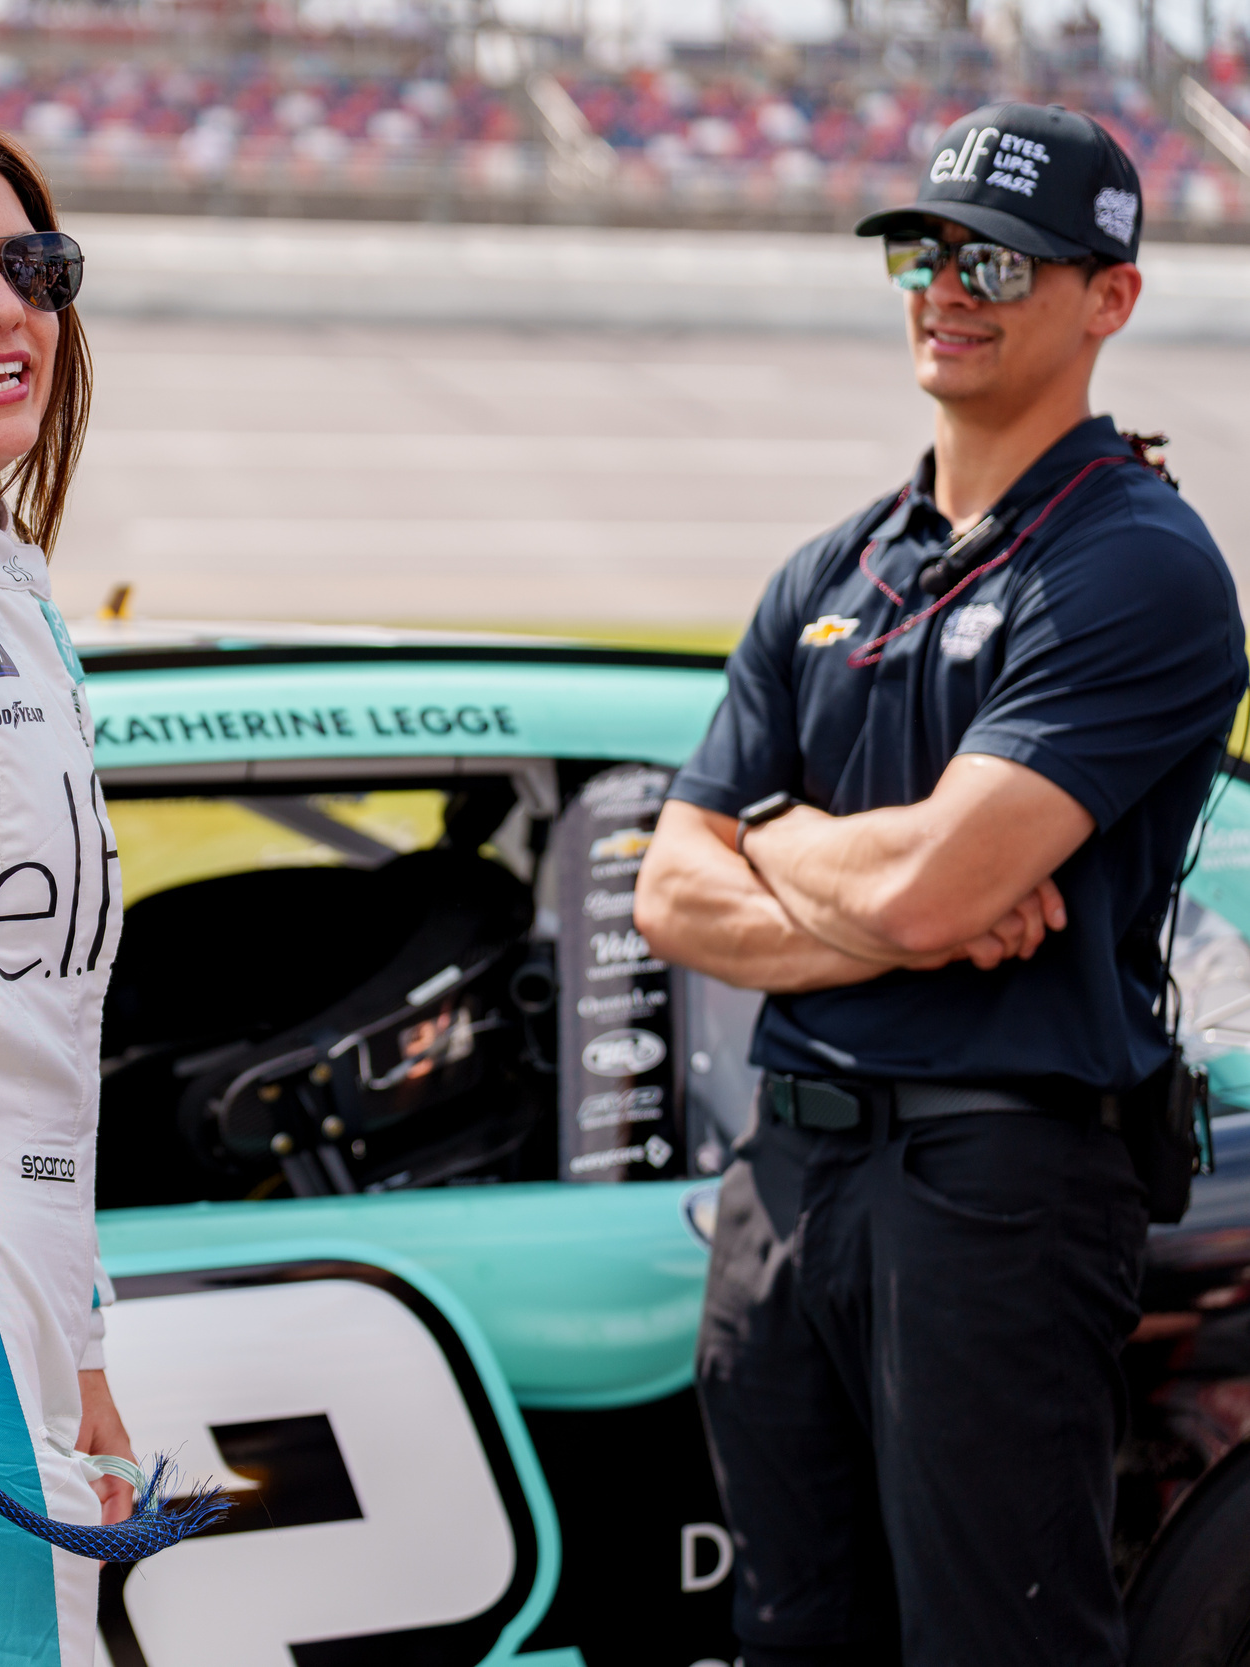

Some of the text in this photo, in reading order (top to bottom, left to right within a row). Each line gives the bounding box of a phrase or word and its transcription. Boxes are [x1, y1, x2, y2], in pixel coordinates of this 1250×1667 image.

[1000, 133, 1050, 164] EYES.
[993, 151, 1039, 180] LIPS.
[93, 707, 355, 747] KATHERINE
[368, 705, 519, 739] LEGGE
[21, 1155, 75, 1183] sparco
